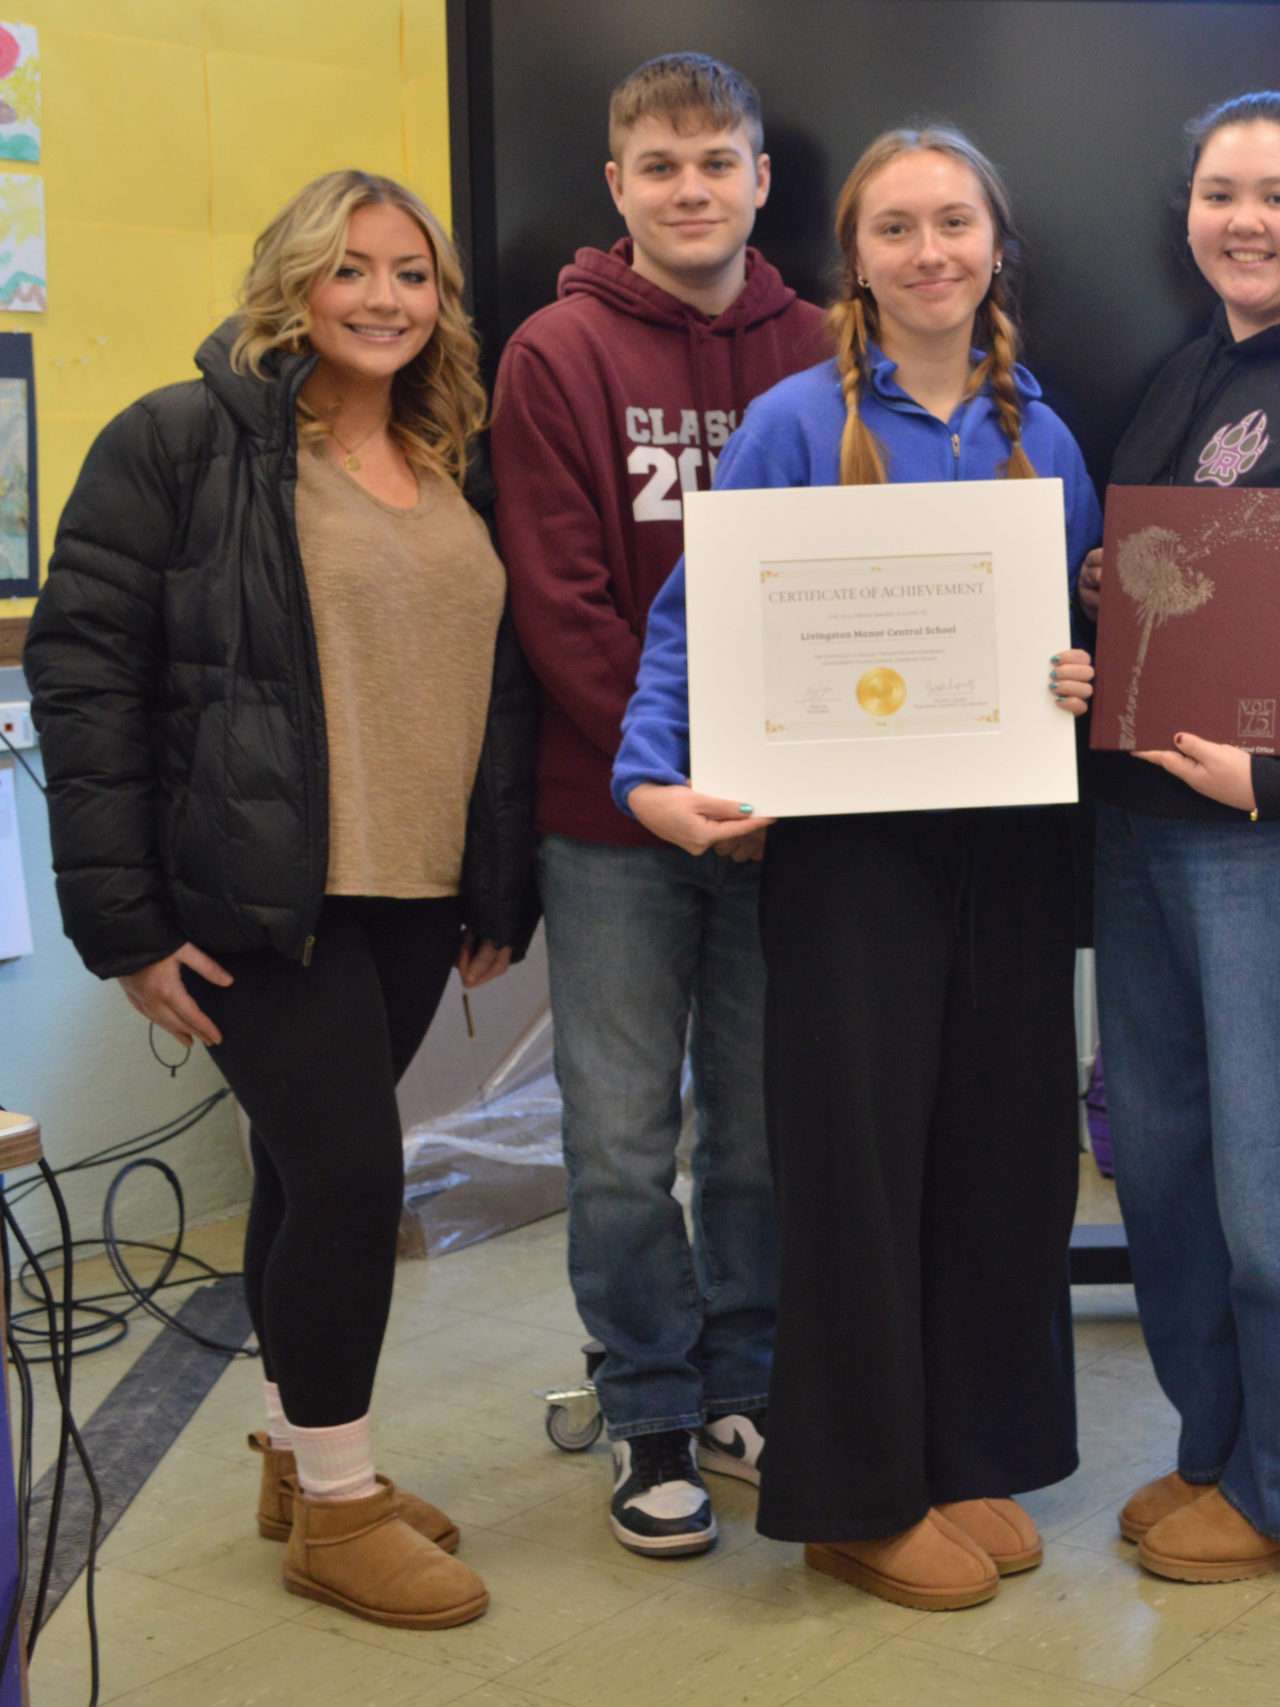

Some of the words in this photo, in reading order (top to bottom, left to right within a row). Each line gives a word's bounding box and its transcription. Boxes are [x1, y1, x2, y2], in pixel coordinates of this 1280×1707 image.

[625, 406, 737, 447] CLAS
[767, 588, 856, 604] CERTIFICATE
[859, 585, 877, 599] OF
[878, 582, 985, 598] ACHIEVEMENT
[800, 630, 852, 643] Livingston
[887, 626, 922, 636] Central
[925, 624, 957, 635] School
